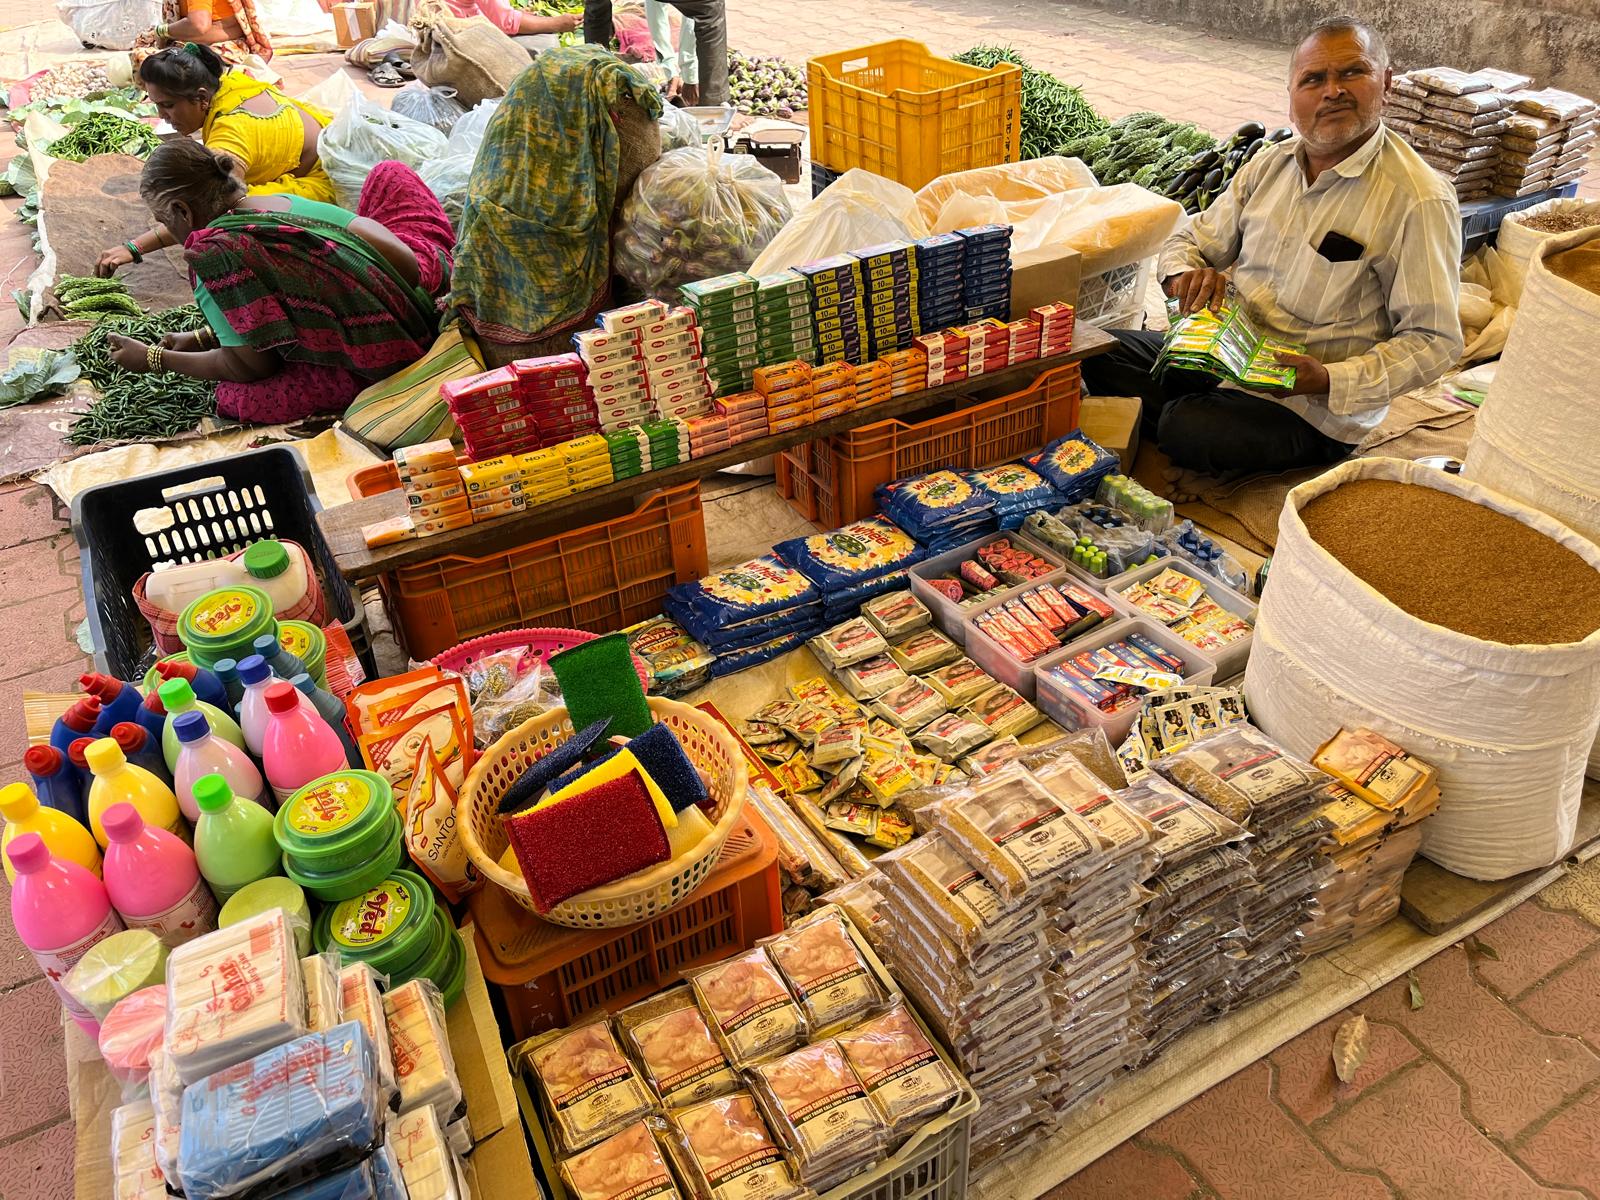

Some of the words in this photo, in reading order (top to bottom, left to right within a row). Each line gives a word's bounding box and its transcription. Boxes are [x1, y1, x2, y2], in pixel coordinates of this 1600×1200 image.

[848, 526, 894, 546] Wheel
[744, 562, 789, 584] Wheel
[428, 808, 456, 860] SANTO
[359, 891, 389, 937] Ved
[659, 1074, 682, 1089] TOBACCO
[680, 1066, 698, 1079] CAUSES
[697, 1057, 716, 1071] PAINFUL
[709, 1164, 732, 1180] TOBACCO
[731, 1155, 750, 1169] CAUSES
